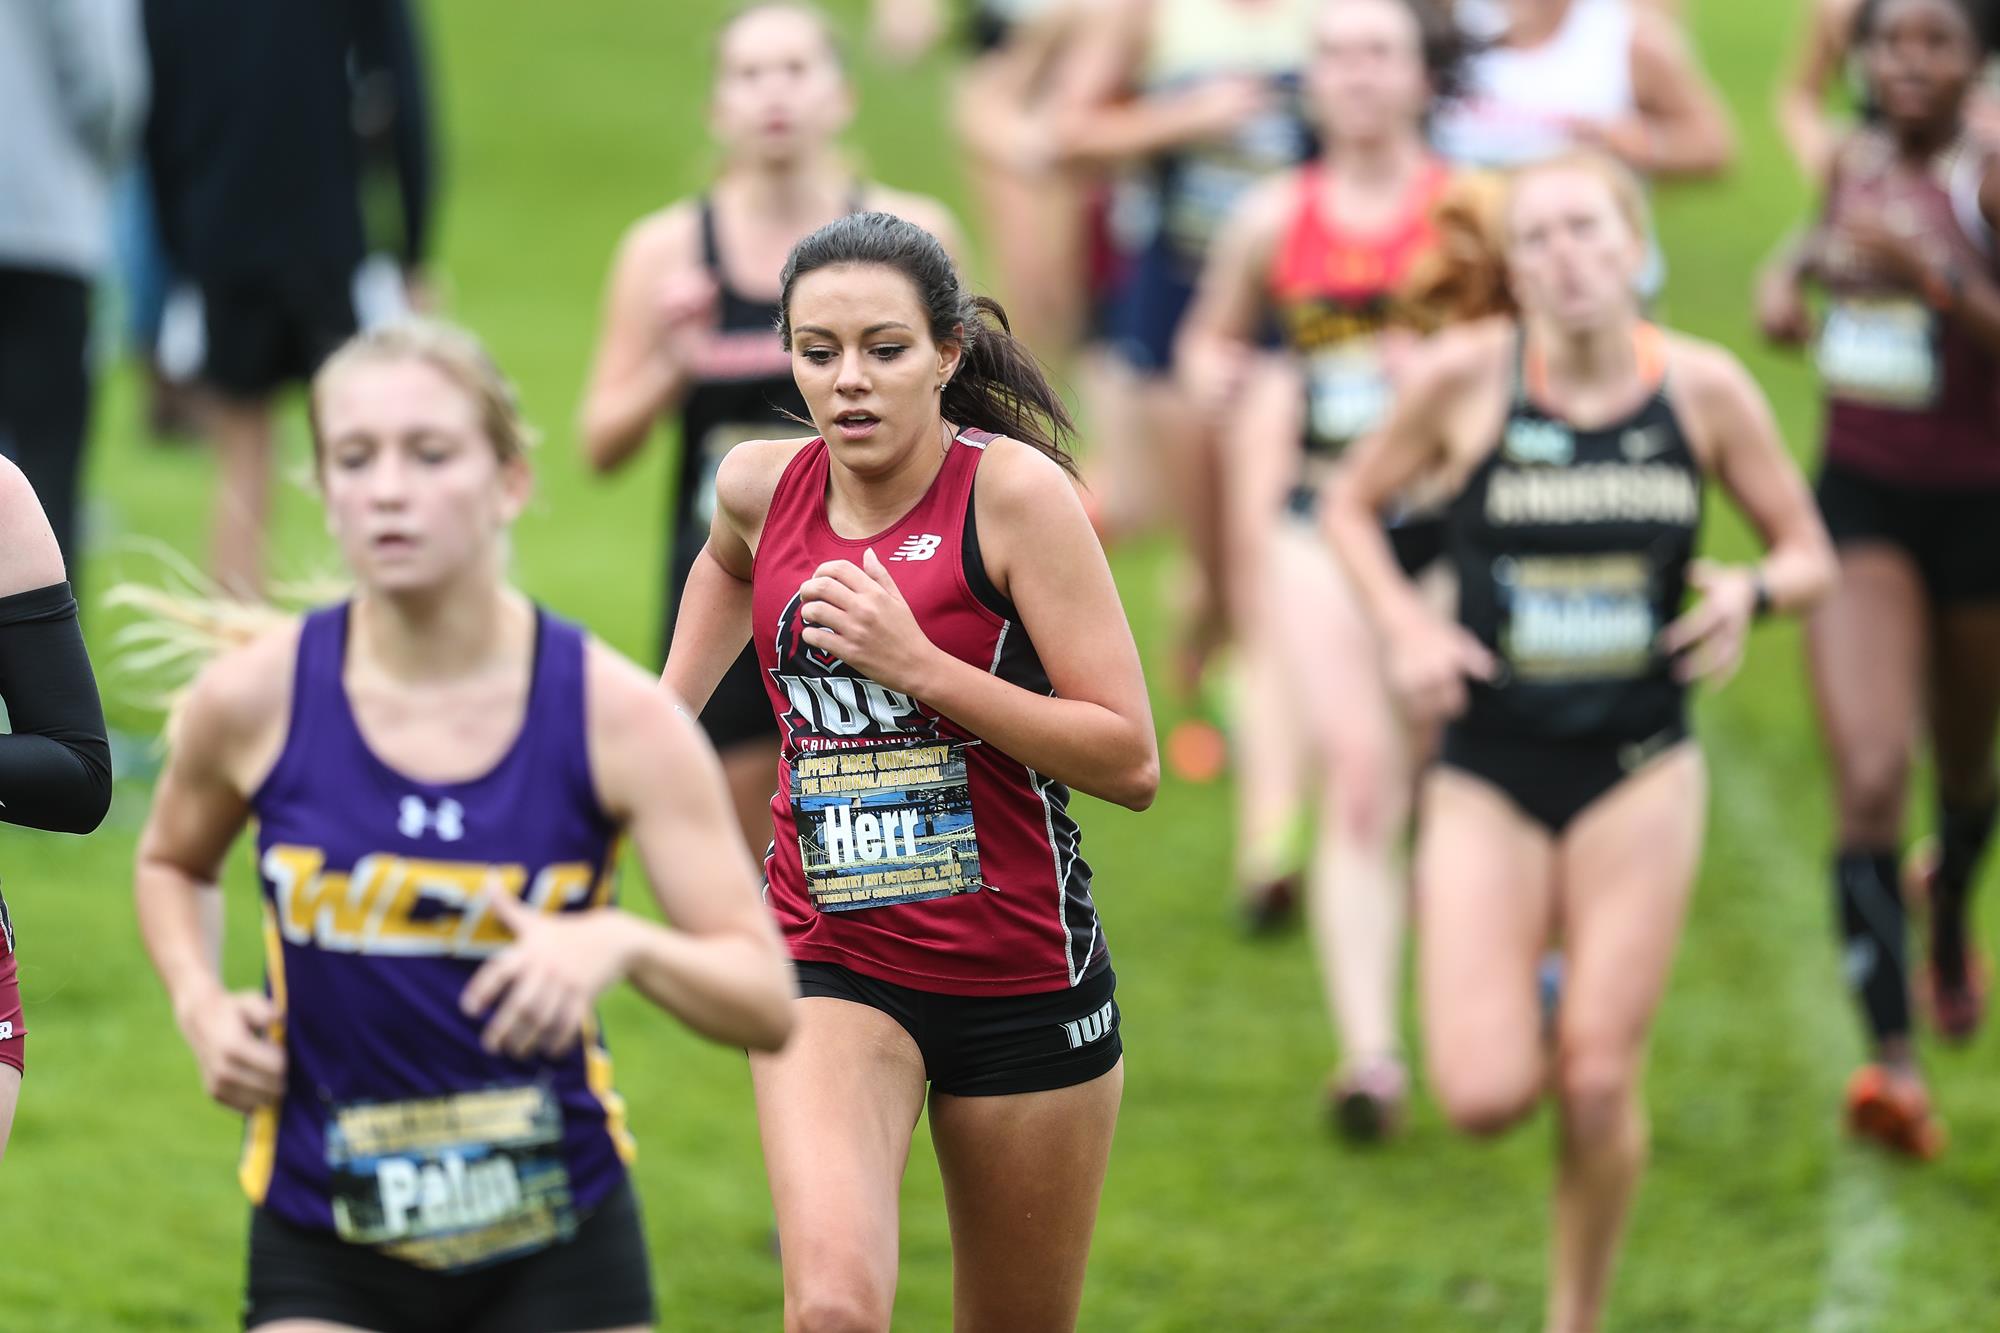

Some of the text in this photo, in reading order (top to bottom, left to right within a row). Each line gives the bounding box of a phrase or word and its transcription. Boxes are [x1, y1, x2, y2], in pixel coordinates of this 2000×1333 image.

[779, 675, 916, 735] IUP
[798, 745, 949, 778] LIPPERY ROCK UNIVERSITY
[825, 804, 919, 865] Herr
[1062, 1000, 1112, 1048] IUP
